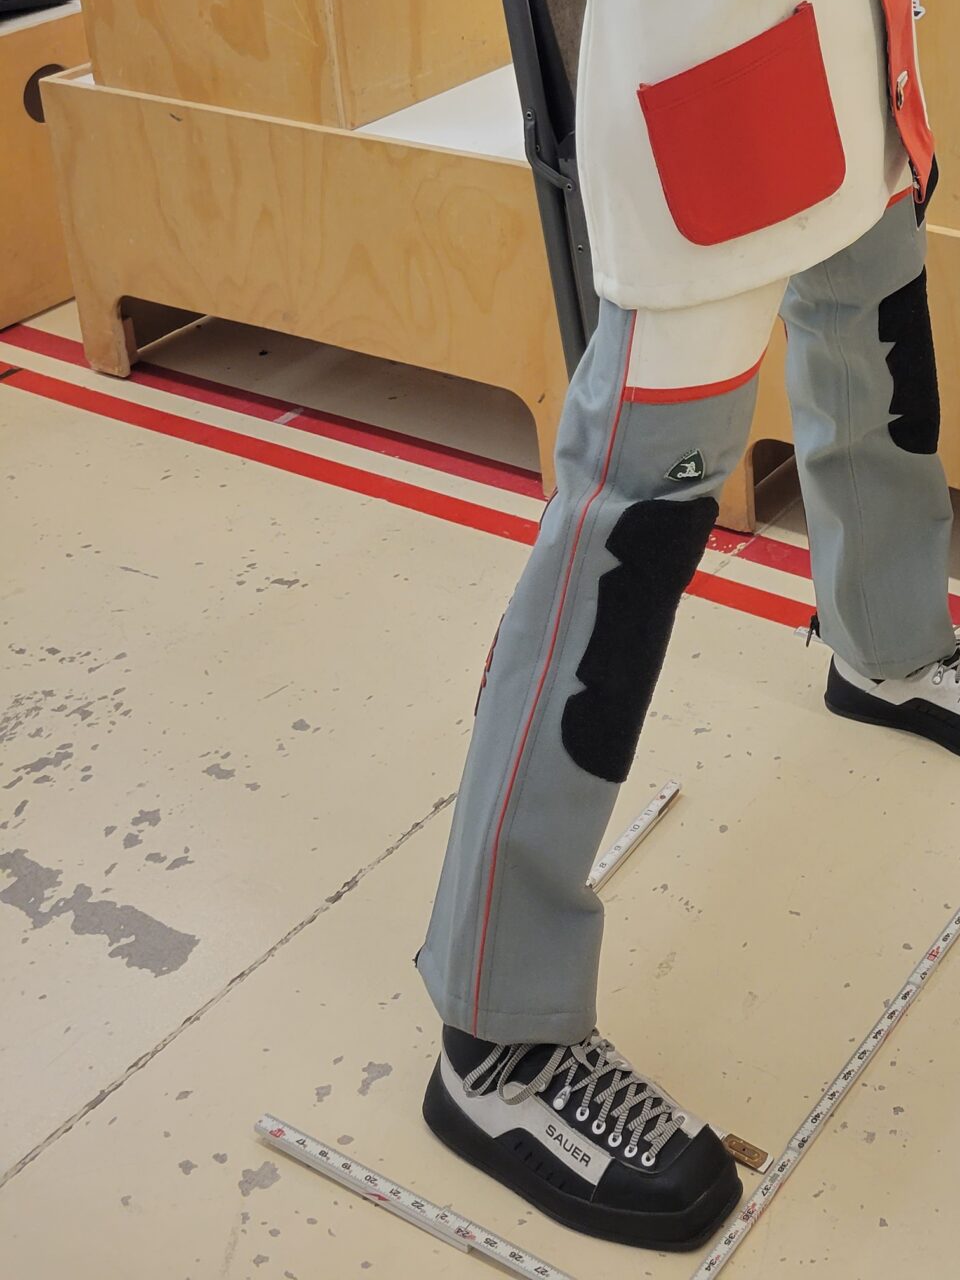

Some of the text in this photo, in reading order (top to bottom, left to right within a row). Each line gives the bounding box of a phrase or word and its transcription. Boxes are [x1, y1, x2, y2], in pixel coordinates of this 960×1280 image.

[630, 824, 640, 832] 10
[942, 933, 950, 942] 49
[920, 971, 928, 980] 47
[872, 1029, 882, 1040] 44
[858, 1050, 868, 1060] 43
[842, 1070, 852, 1081] 42
[828, 1091, 837, 1101] 41
[811, 1113, 821, 1124] 40
[545, 1124, 592, 1168] SAUER
[798, 1136, 808, 1148] 39
[319, 1150, 329, 1158] 18
[342, 1162, 351, 1170] 19
[778, 1161, 788, 1172] 38
[364, 1175, 378, 1183] 20
[389, 1188, 401, 1197] 21
[762, 1184, 771, 1196] 37
[411, 1200, 424, 1209] 22
[454, 1228, 470, 1238] 24
[484, 1237, 498, 1247] 25
[724, 1233, 735, 1246] 35
[509, 1251, 523, 1261] 26
[534, 1266, 549, 1275] 27
[705, 1259, 716, 1272] 34
